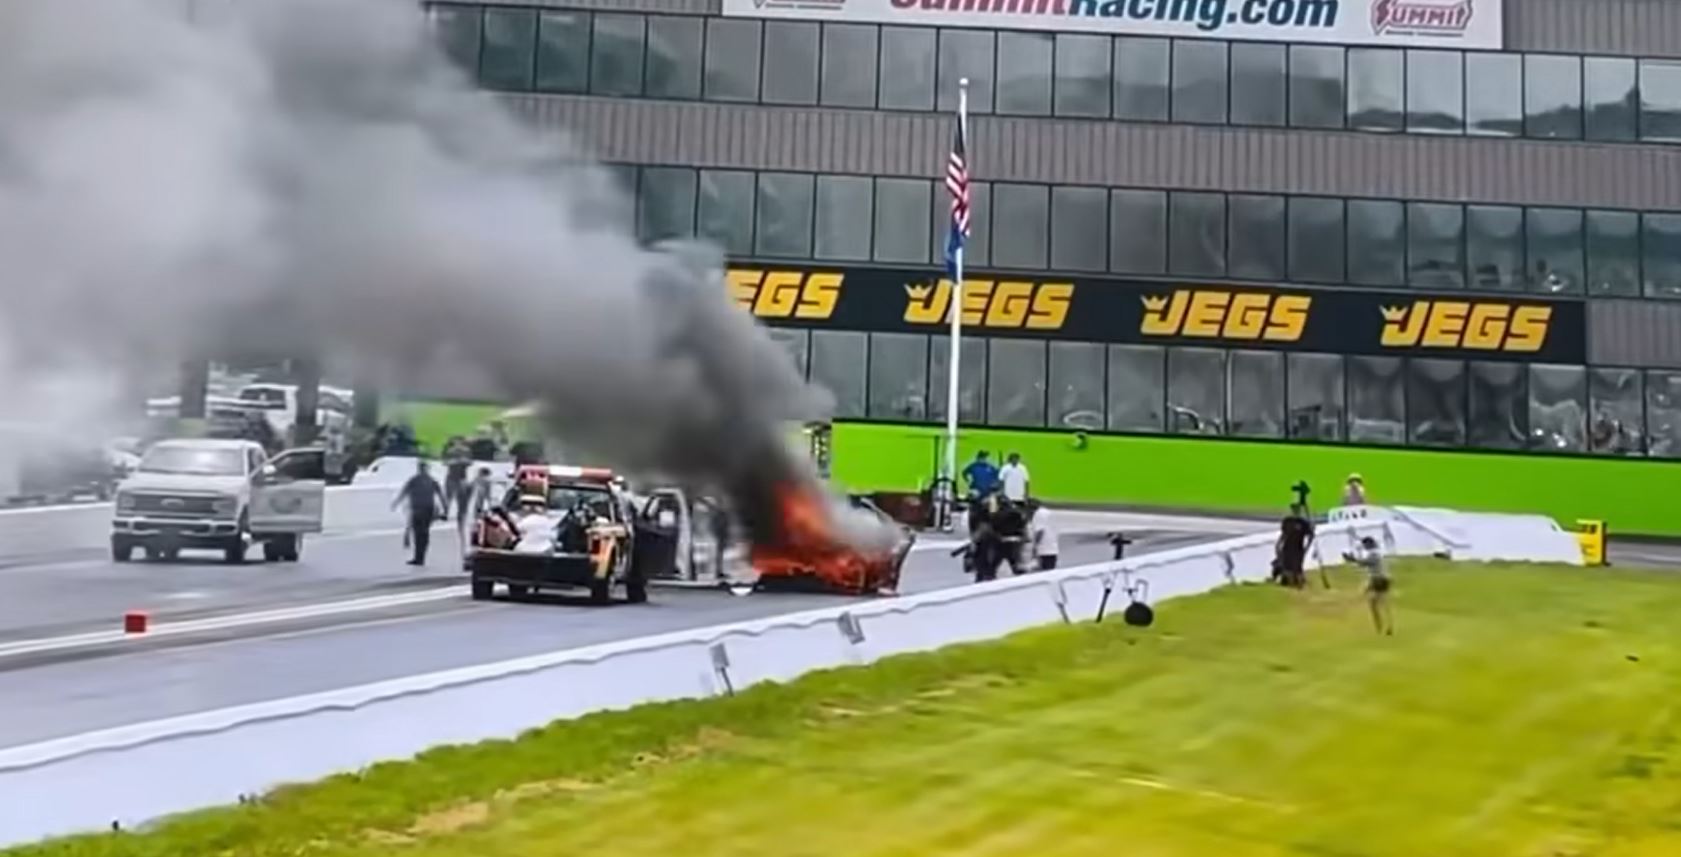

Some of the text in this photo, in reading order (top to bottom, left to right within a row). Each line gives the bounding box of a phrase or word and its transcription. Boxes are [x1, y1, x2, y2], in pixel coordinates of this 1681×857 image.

[889, 0, 1338, 31] acing.com
[727, 269, 844, 319] EGS
[904, 279, 1075, 328] JEGS
[1140, 290, 1312, 341] JEGS
[1381, 301, 1552, 351] JEGS
